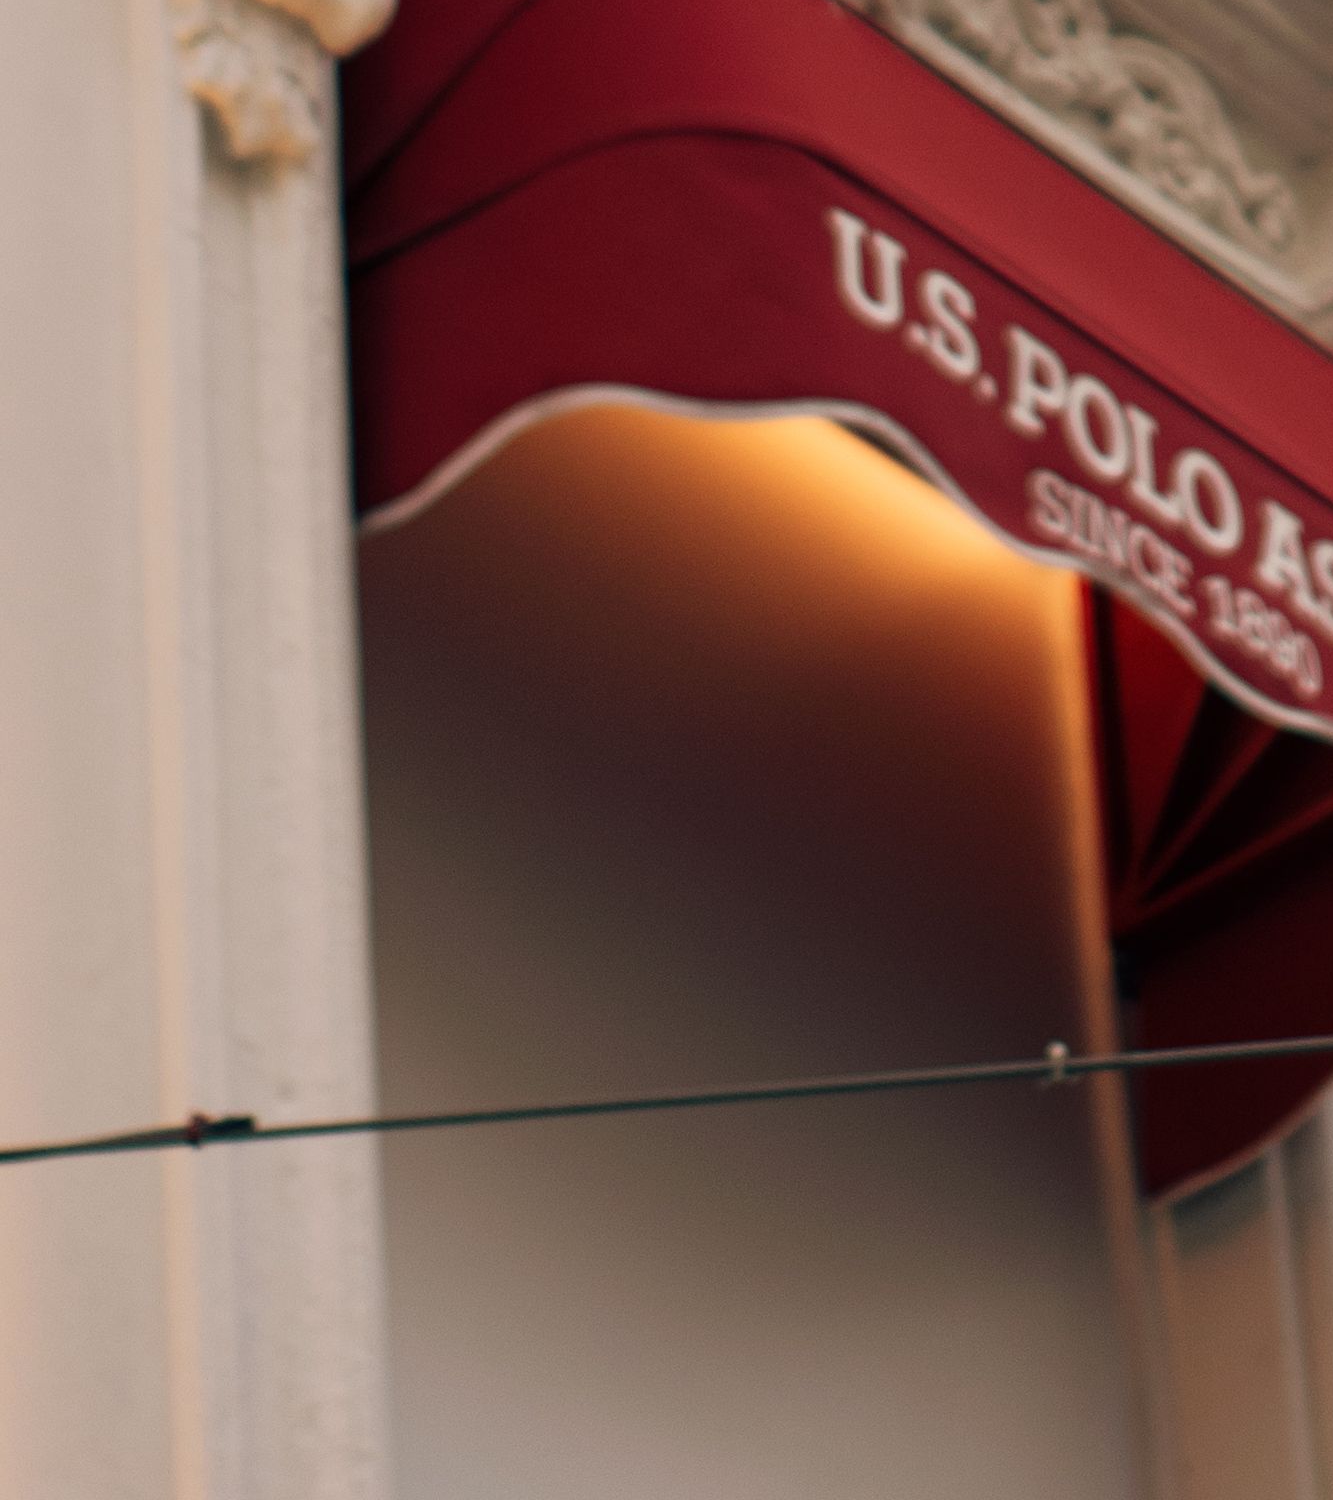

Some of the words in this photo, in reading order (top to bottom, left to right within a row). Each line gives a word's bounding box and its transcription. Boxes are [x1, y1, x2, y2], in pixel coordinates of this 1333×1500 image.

[827, 204, 997, 398] U.S.
[1003, 323, 1245, 556] POLO
[1028, 467, 1197, 619] SINCE
